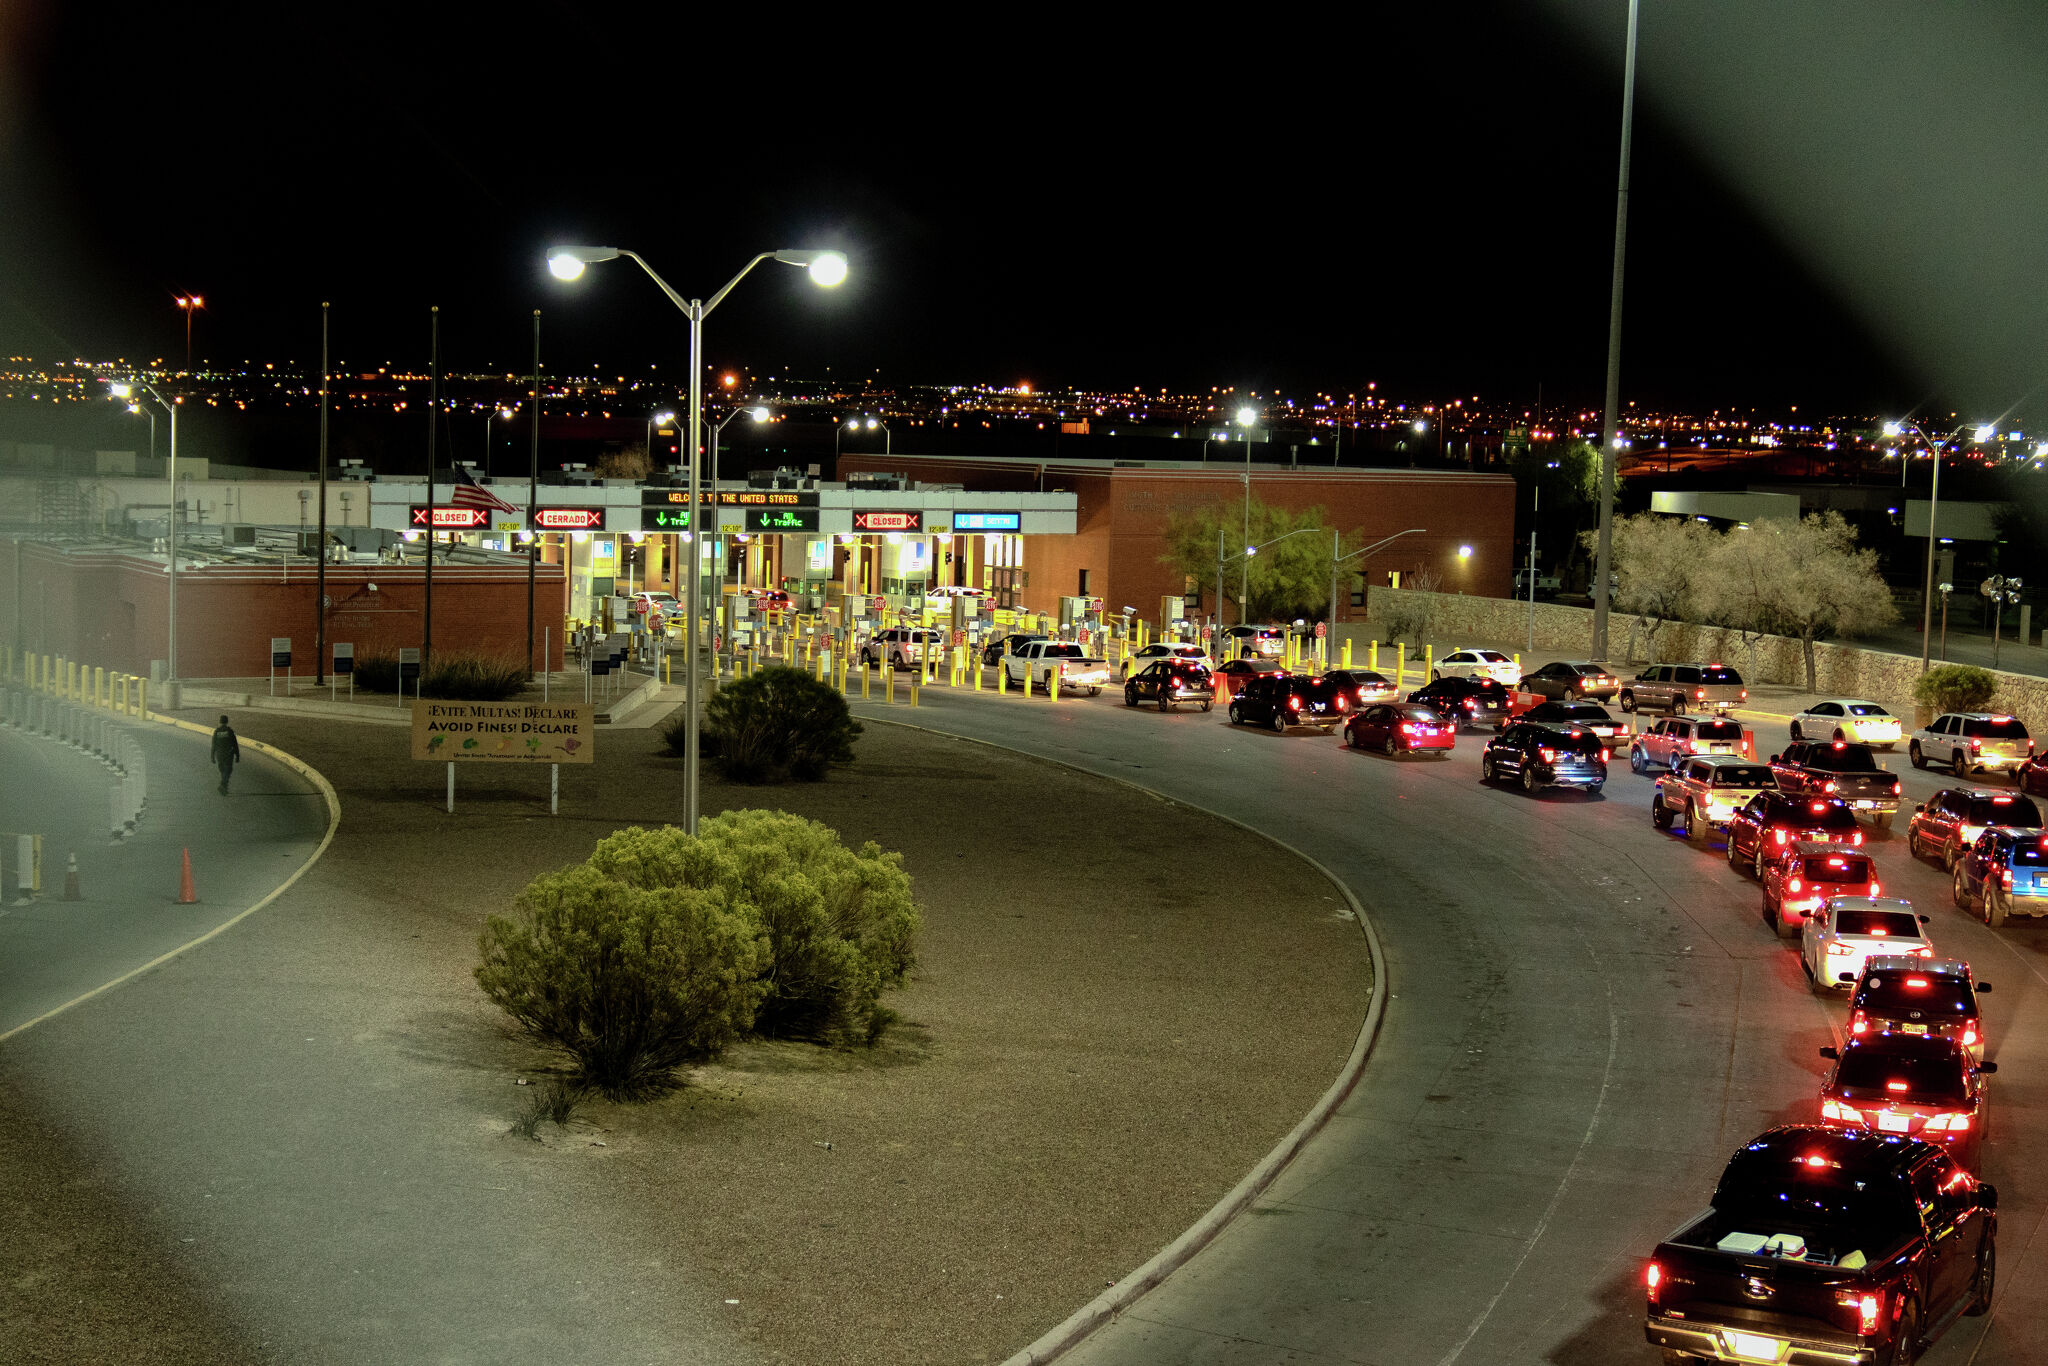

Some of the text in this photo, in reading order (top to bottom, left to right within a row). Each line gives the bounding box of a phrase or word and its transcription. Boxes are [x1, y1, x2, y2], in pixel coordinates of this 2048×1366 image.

[669, 493, 703, 502] WELCE
[722, 494, 737, 503] THE
[740, 494, 765, 503] UNITED
[769, 495, 798, 504] STATES
[433, 513, 467, 522] CLOSED
[547, 515, 586, 523] CERRADO
[670, 518, 689, 526] Traf
[773, 518, 803, 526] Traffic
[873, 517, 902, 526] CLOSED
[428, 705, 578, 720] ¡EVITE MULTAS! DECLARE
[427, 721, 578, 735] AVOID FINES! DECLARE
